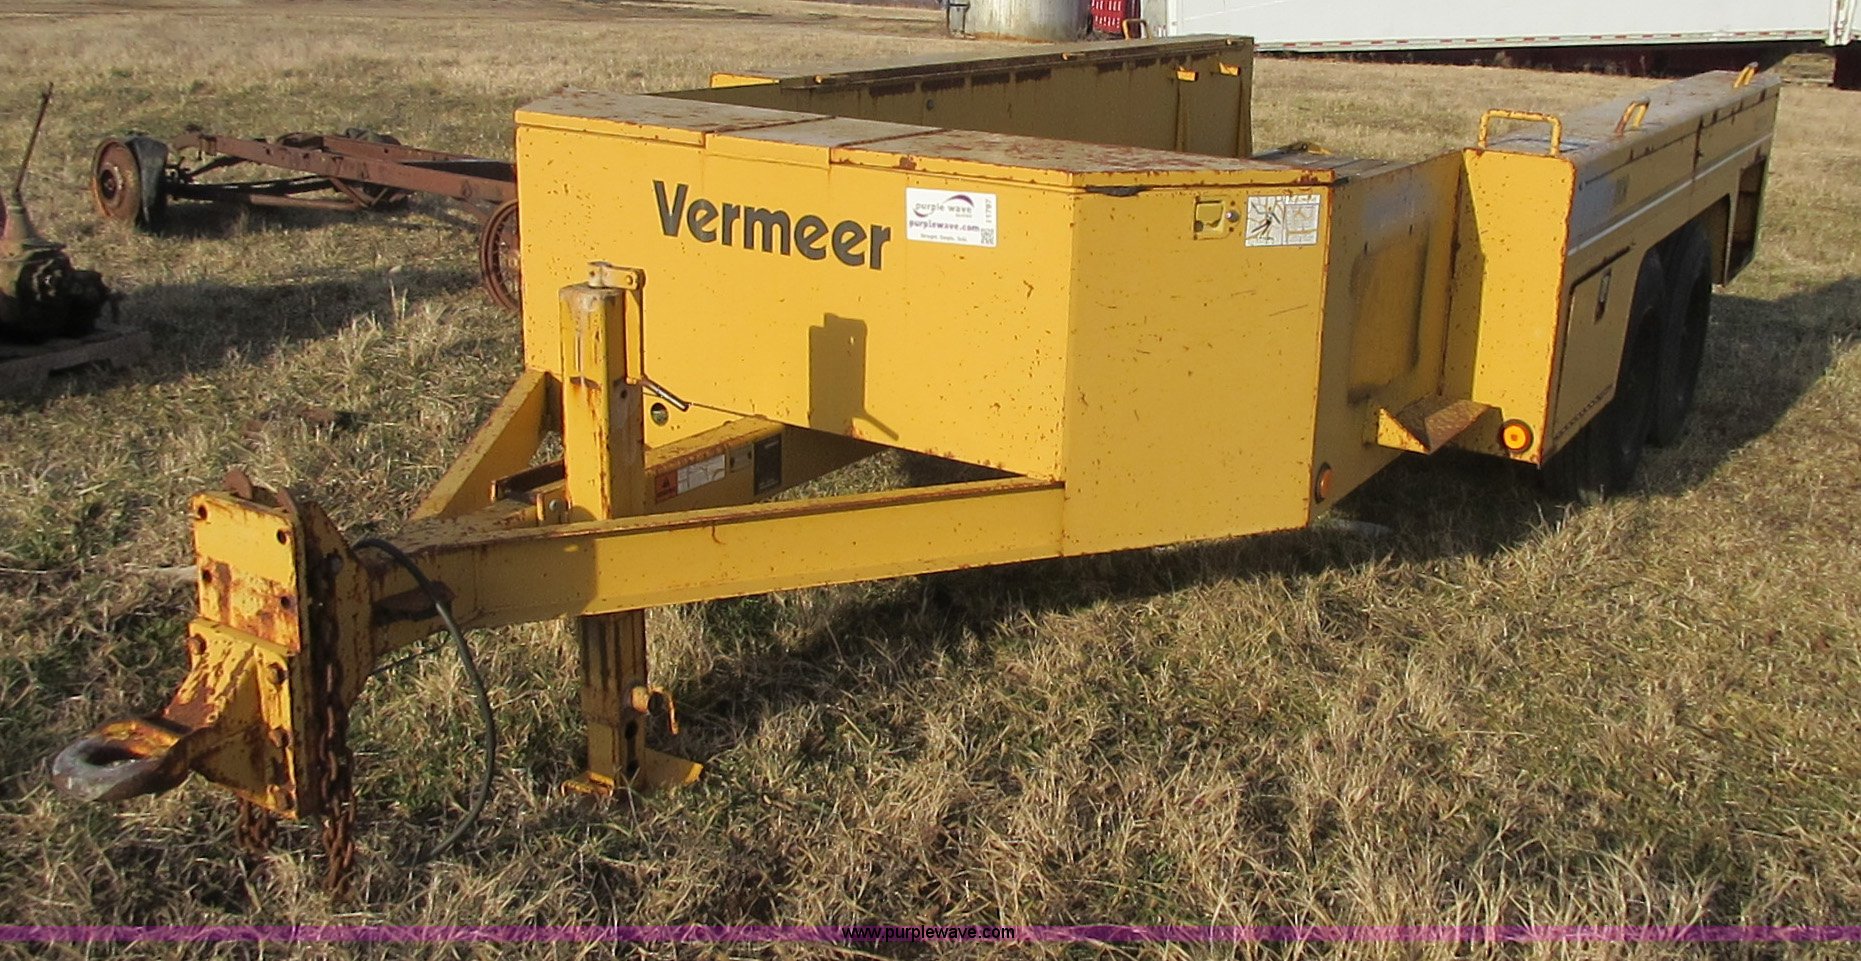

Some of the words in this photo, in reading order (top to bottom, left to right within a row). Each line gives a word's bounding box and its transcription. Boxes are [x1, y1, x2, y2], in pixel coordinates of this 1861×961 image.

[915, 202, 945, 212] purple
[947, 205, 972, 213] wave
[653, 180, 891, 271] Vermeer
[909, 220, 980, 231] purplewave.com
